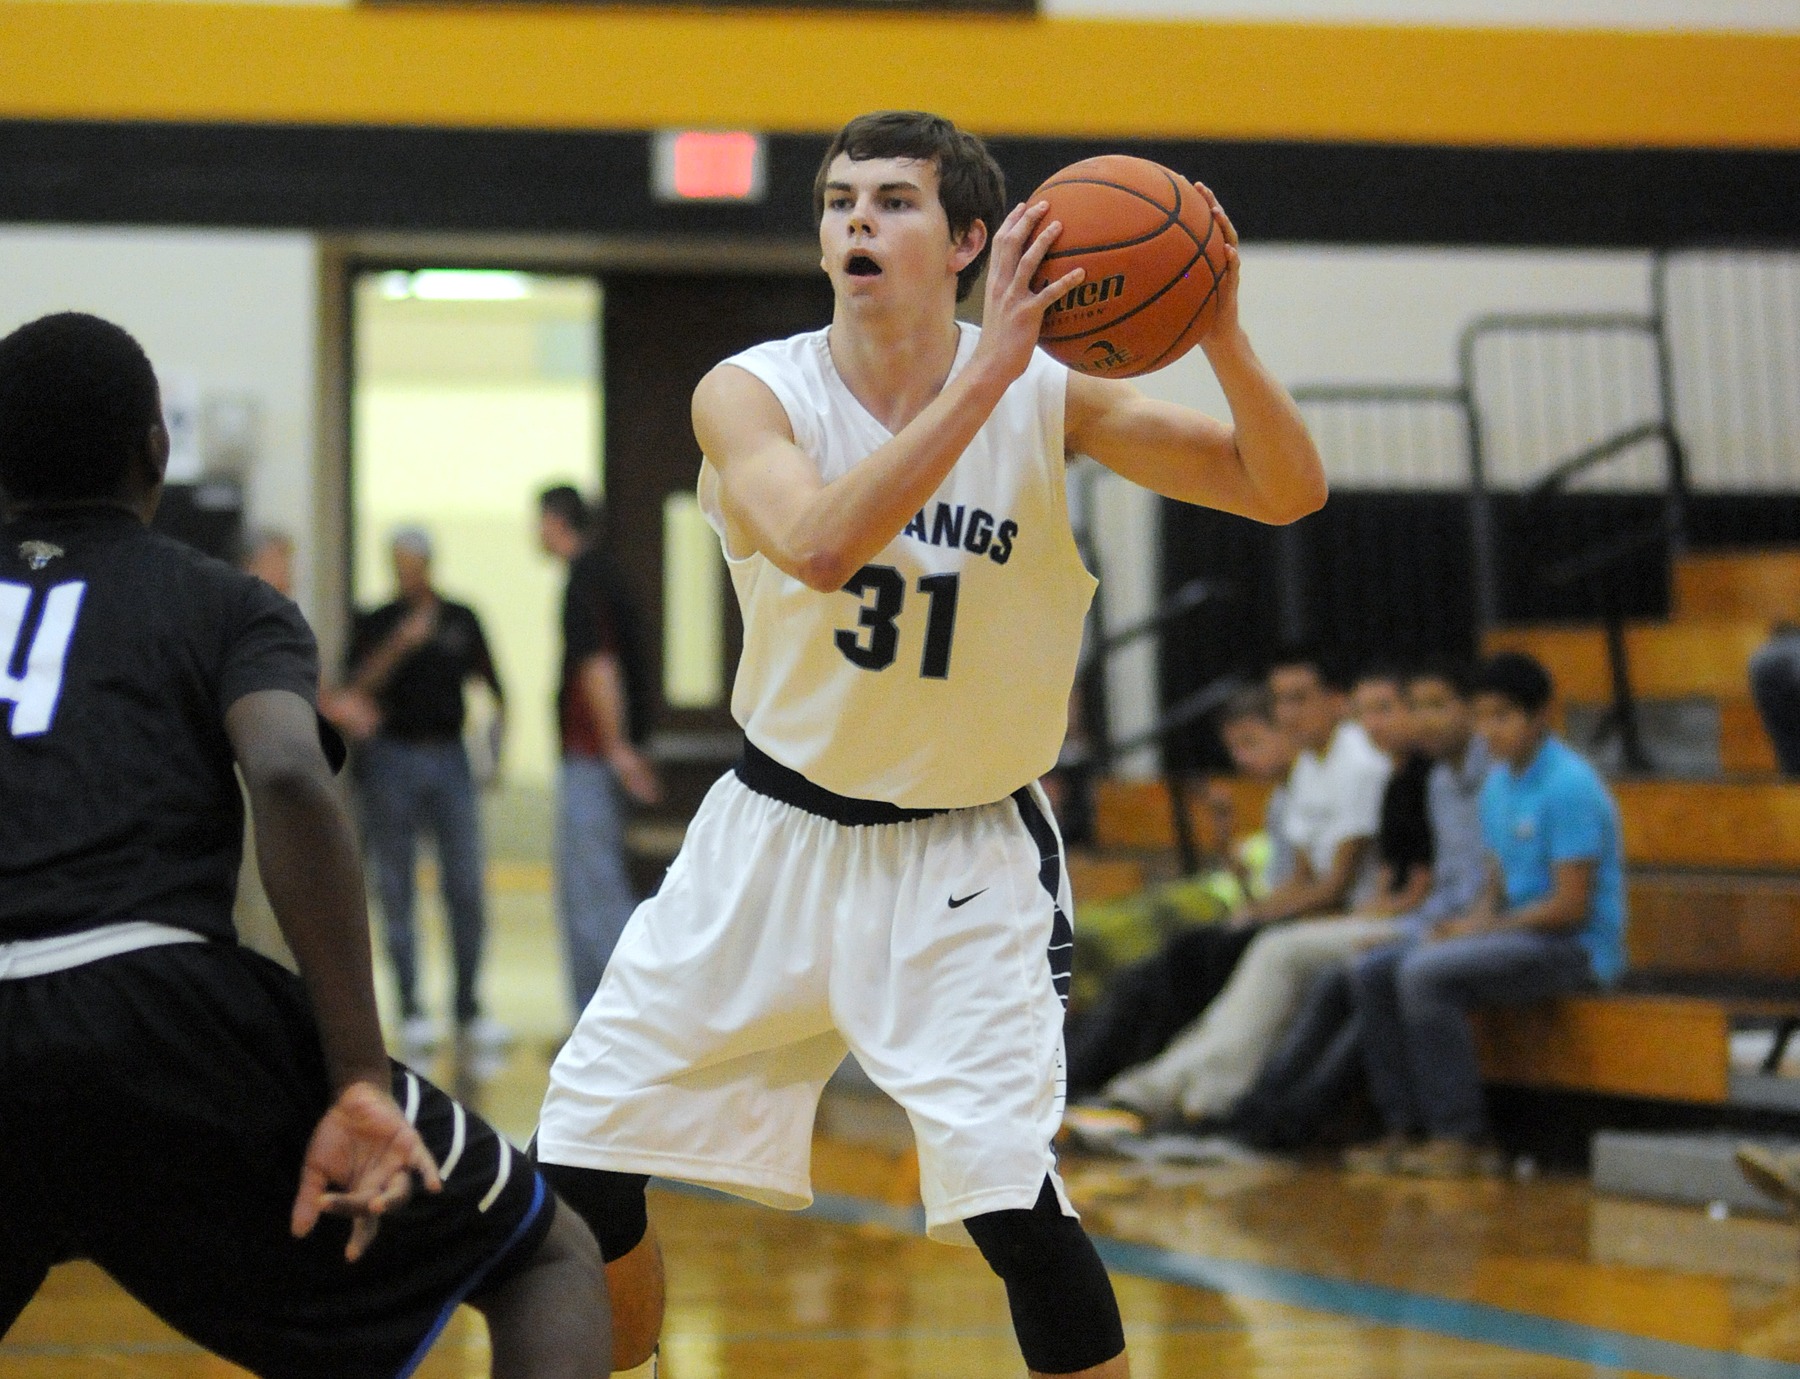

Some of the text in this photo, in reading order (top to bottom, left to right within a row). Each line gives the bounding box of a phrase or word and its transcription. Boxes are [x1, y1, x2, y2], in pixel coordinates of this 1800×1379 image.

[903, 502, 1018, 565] ANGS
[0, 575, 88, 740] 4
[833, 563, 960, 680] 31
